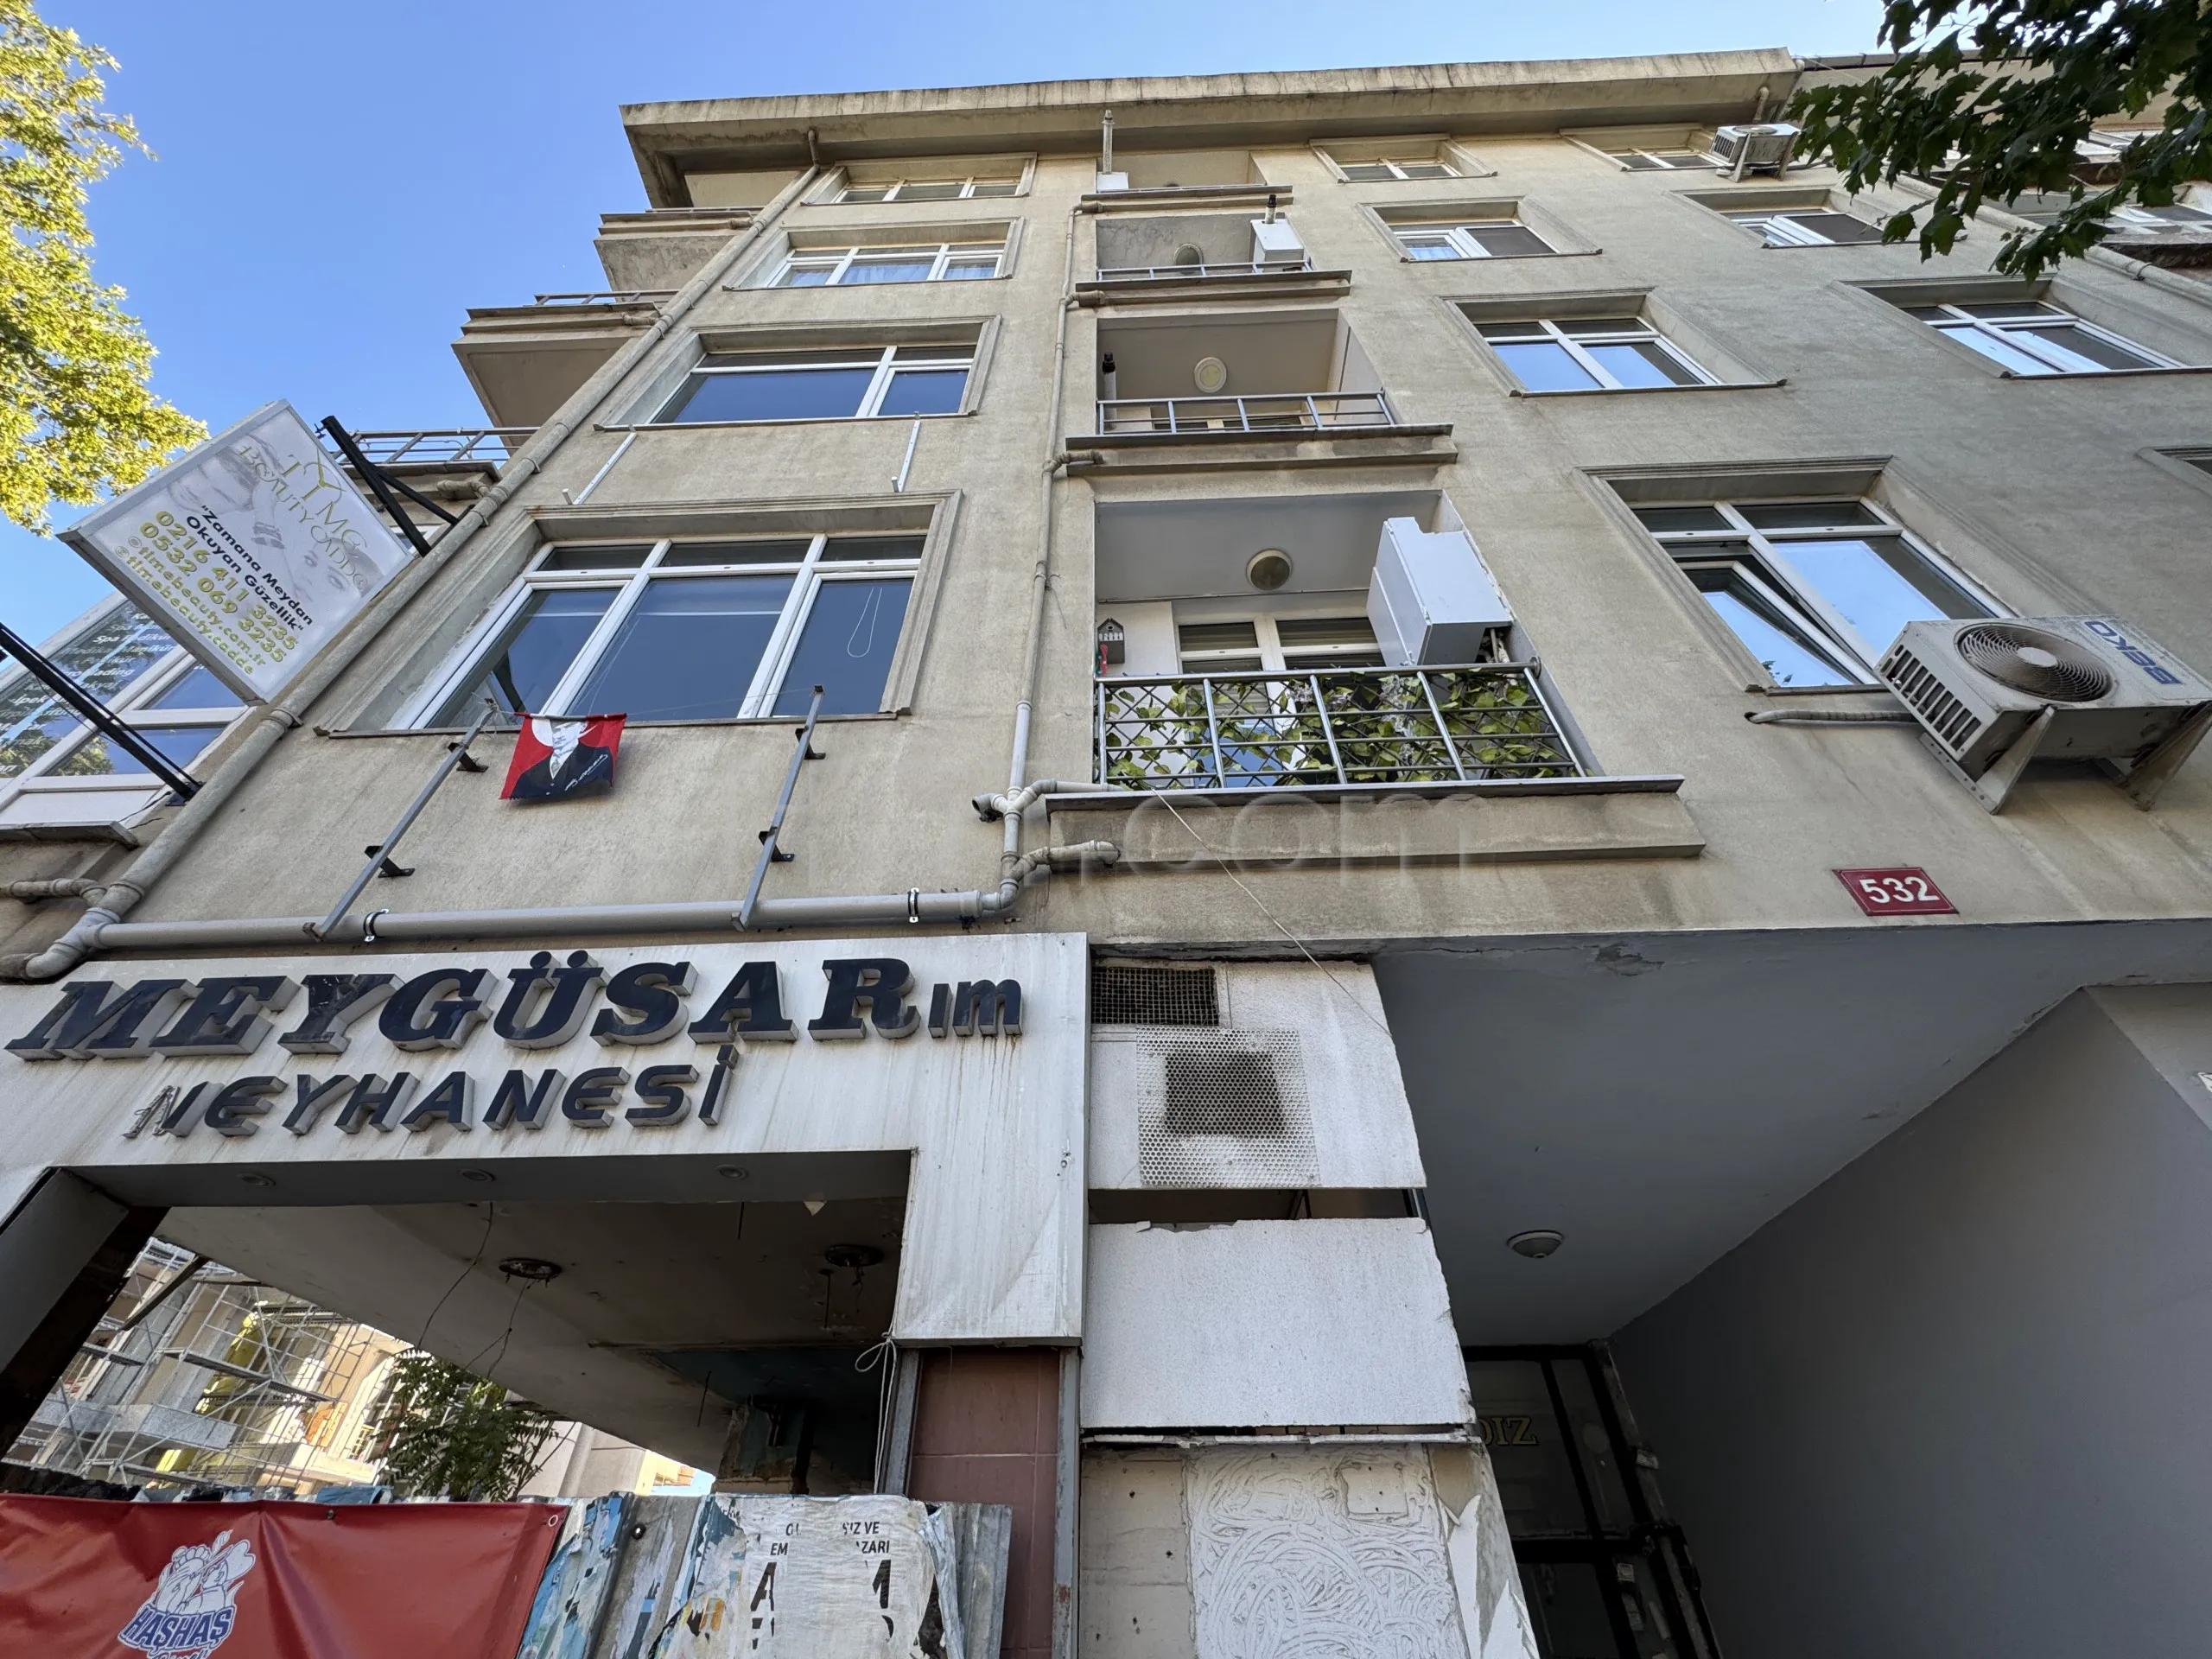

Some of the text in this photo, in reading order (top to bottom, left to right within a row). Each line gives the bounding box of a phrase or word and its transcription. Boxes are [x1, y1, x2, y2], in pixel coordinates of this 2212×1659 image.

[186, 516, 242, 574] Okuyan
[140, 522, 286, 663] 0532 069 3235
[156, 511, 298, 650] 0216 411 3235
[262, 572, 313, 626] Meydan
[1859, 876, 1940, 904] 532
